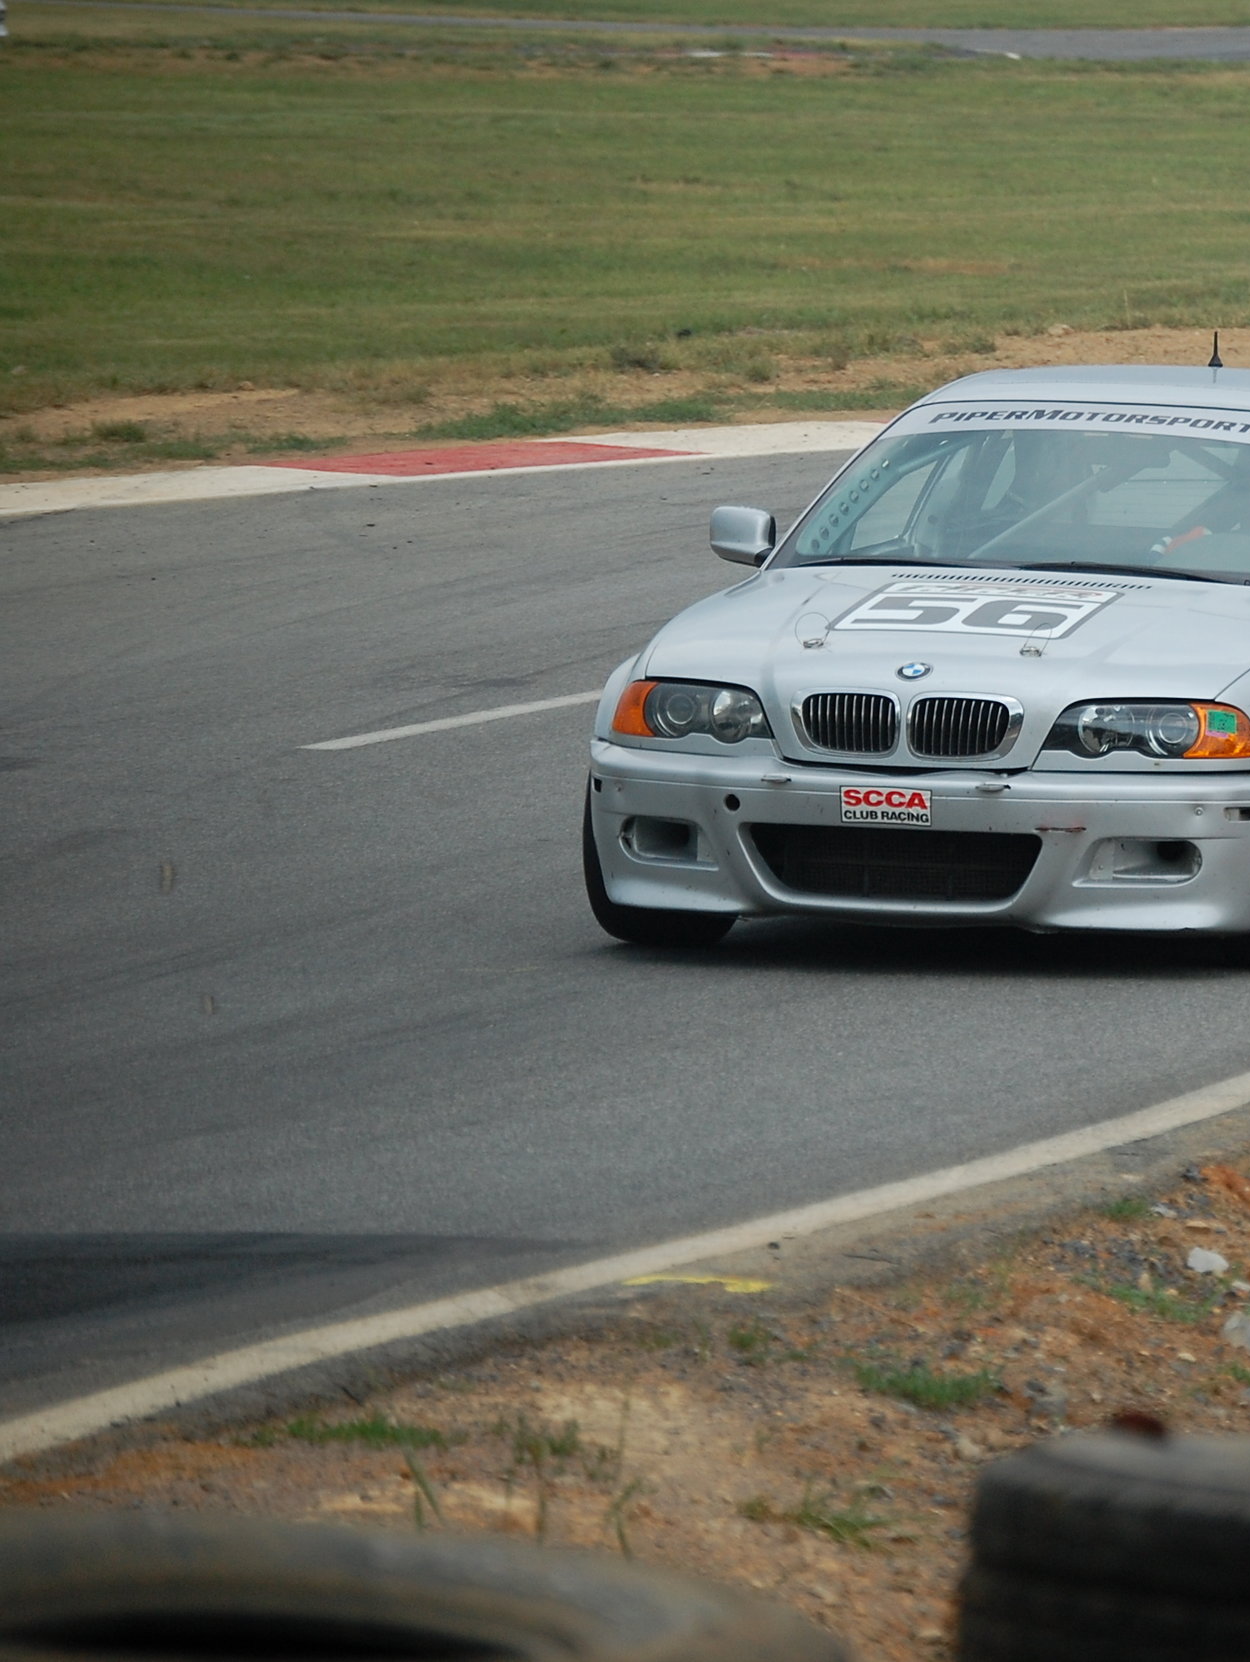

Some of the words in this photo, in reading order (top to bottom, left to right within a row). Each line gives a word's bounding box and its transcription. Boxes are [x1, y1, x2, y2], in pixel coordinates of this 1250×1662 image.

[850, 595, 1085, 631] 56
[843, 789, 928, 810] SCCA
[843, 810, 878, 820] CLUB
[881, 811, 929, 823] RACING
